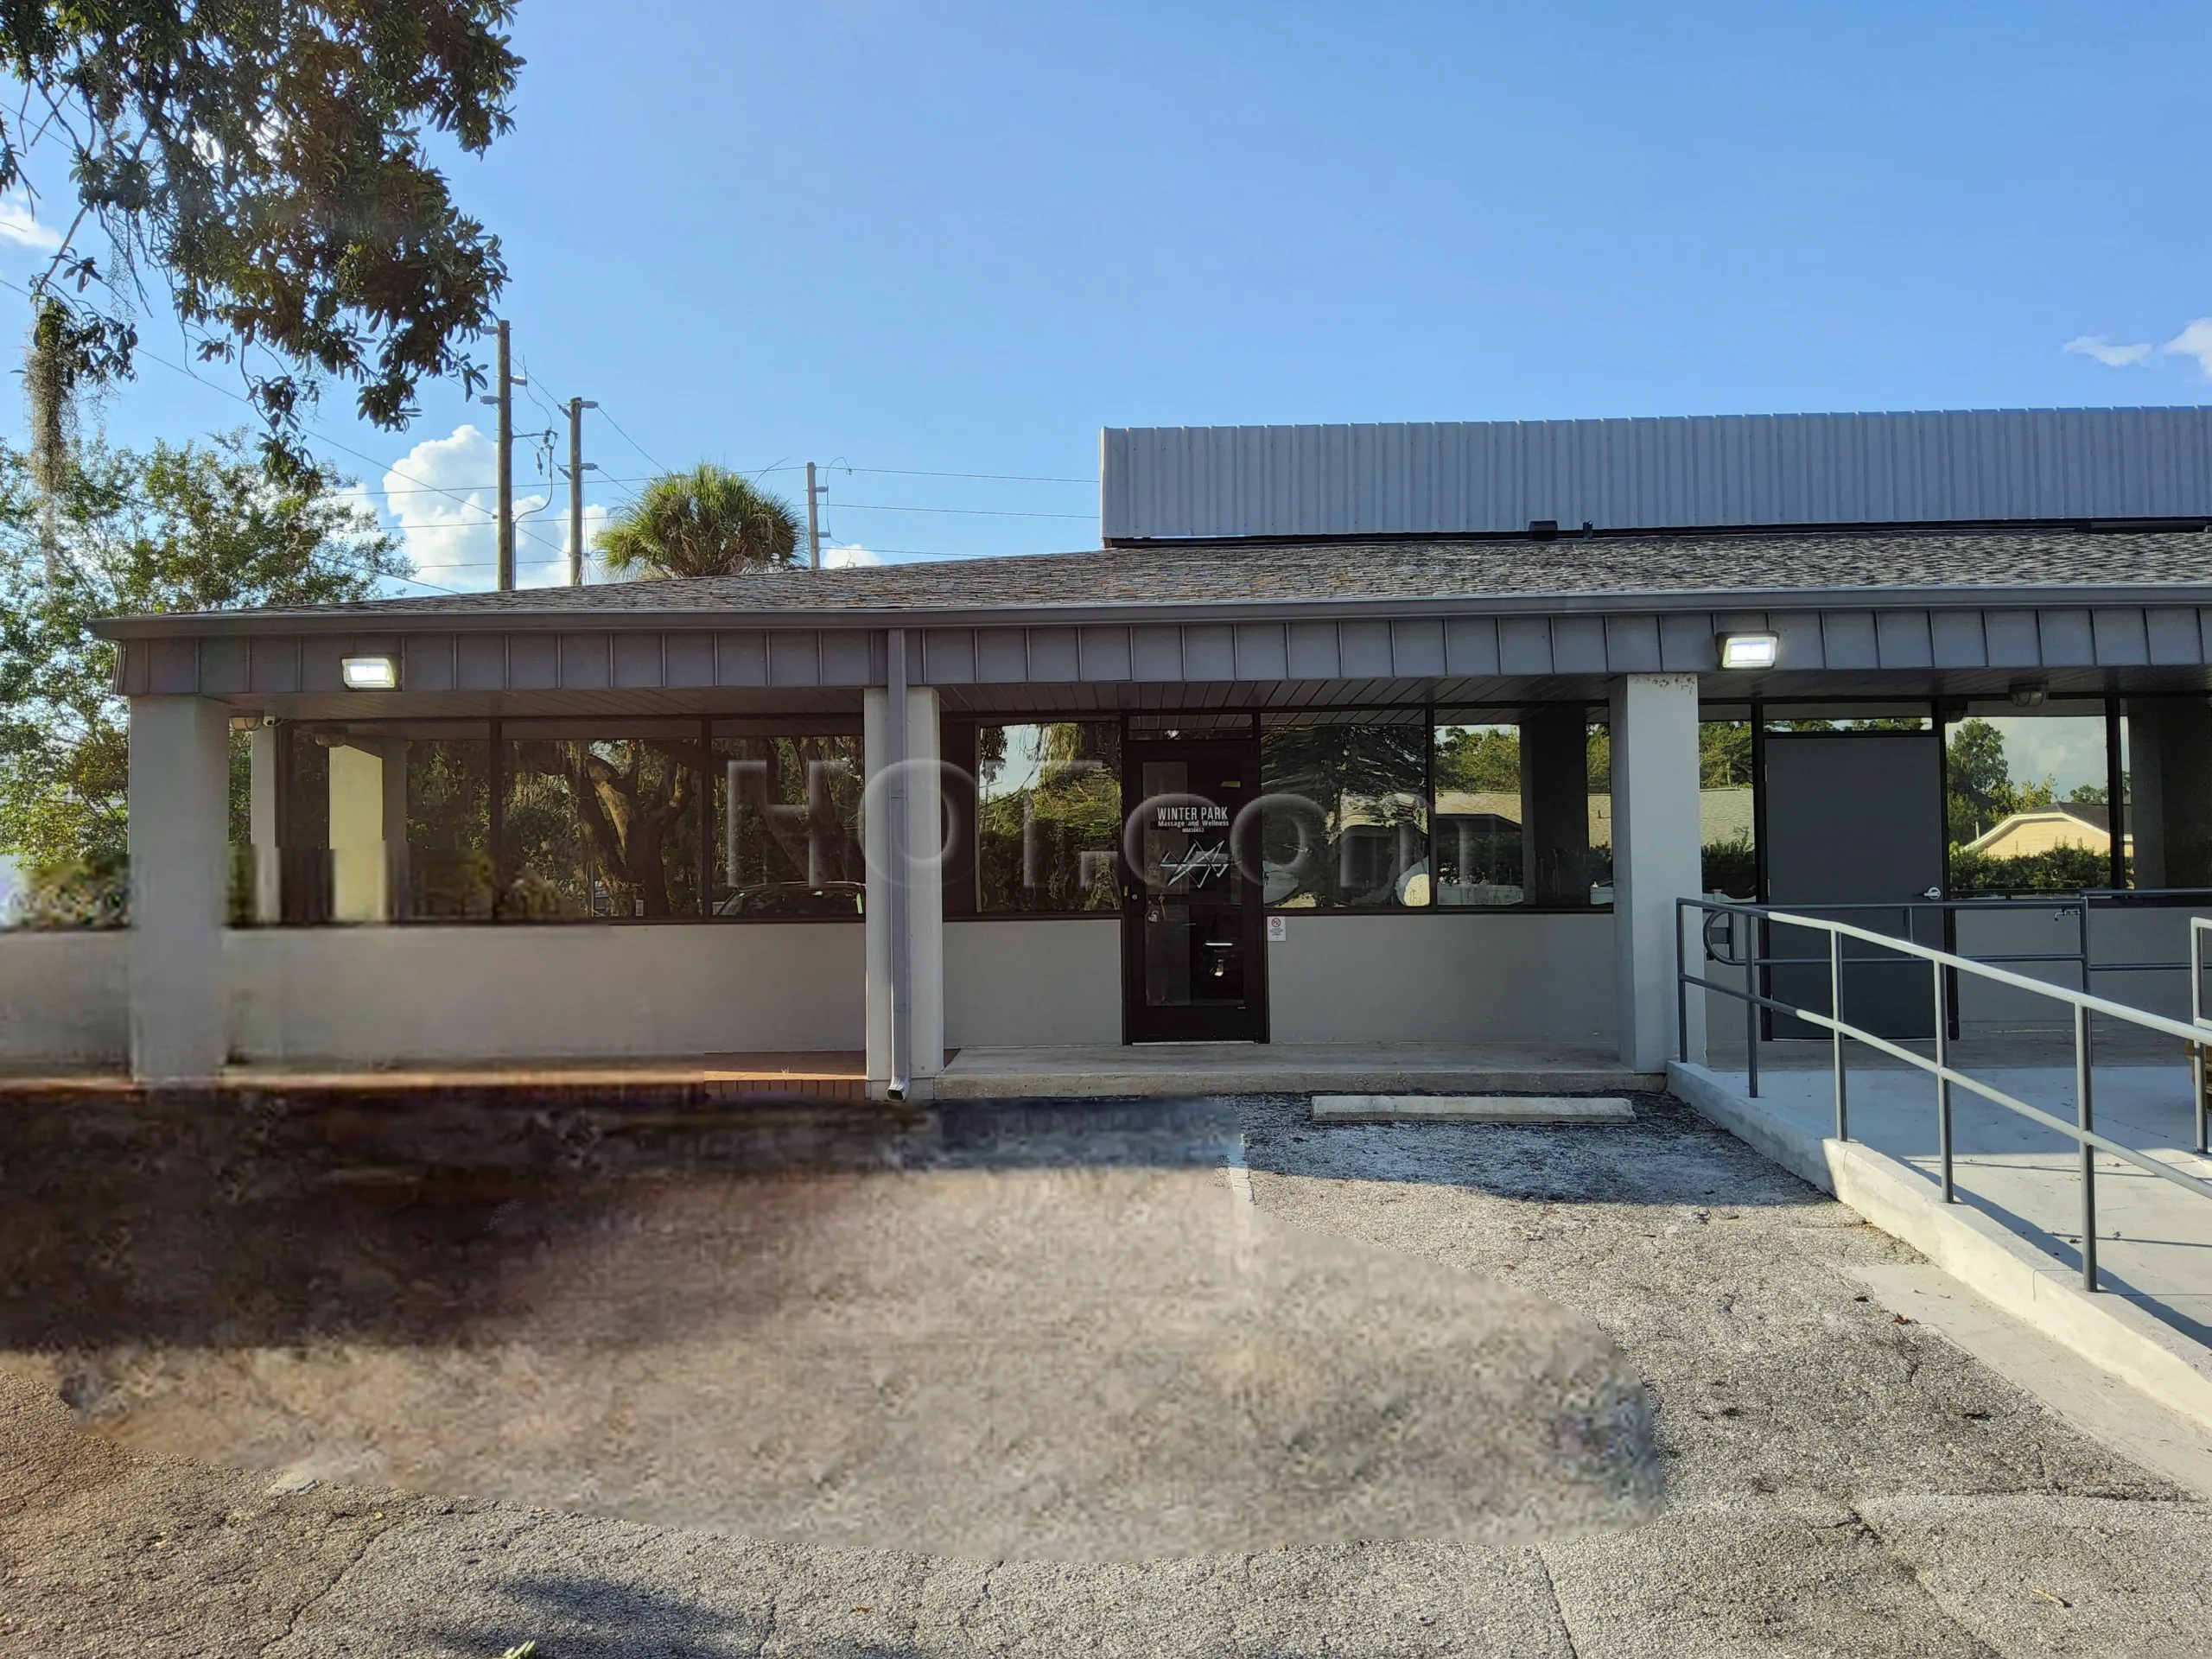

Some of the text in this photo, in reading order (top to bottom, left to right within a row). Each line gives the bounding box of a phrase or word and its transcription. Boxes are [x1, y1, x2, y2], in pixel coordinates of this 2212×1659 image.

[1157, 806, 1228, 821] WINTER PARK
[1158, 820, 1185, 829] Massage
